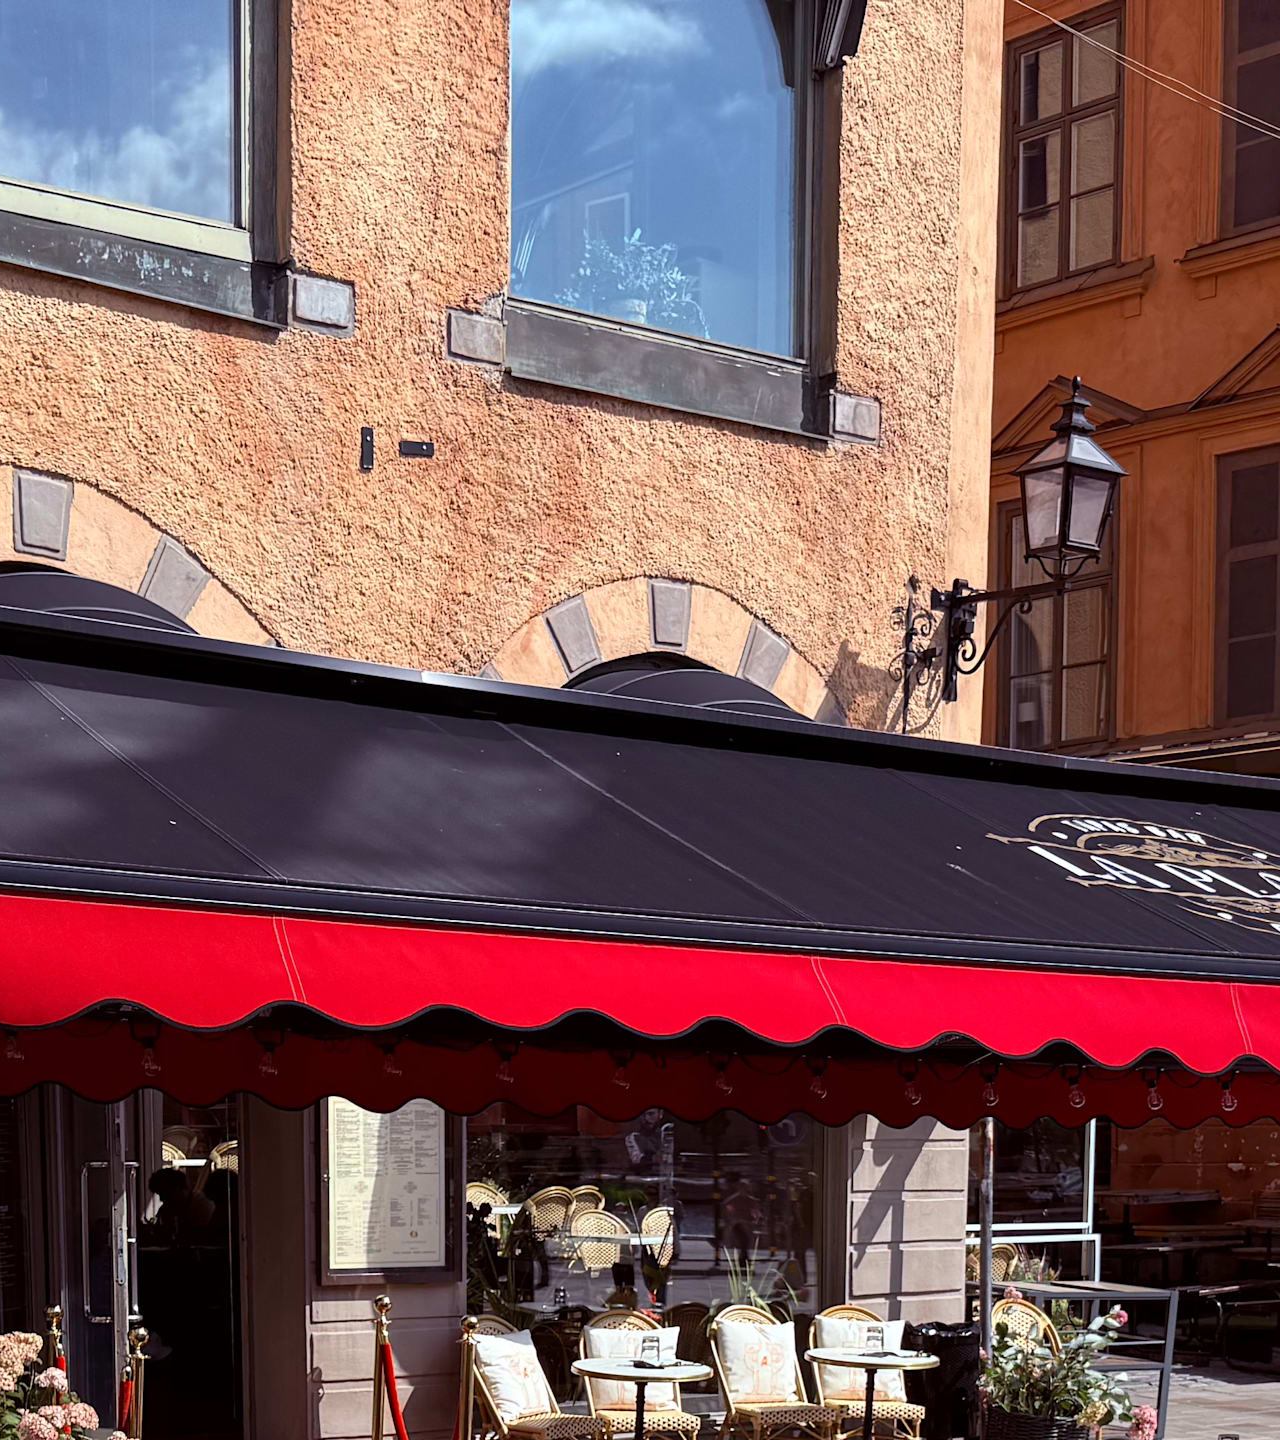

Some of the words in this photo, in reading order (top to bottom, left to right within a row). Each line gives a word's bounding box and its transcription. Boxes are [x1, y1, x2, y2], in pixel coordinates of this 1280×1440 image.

[1061, 819, 1139, 835] TAPAS
[1144, 825, 1206, 845] BAR
[1027, 845, 1171, 888] LA
